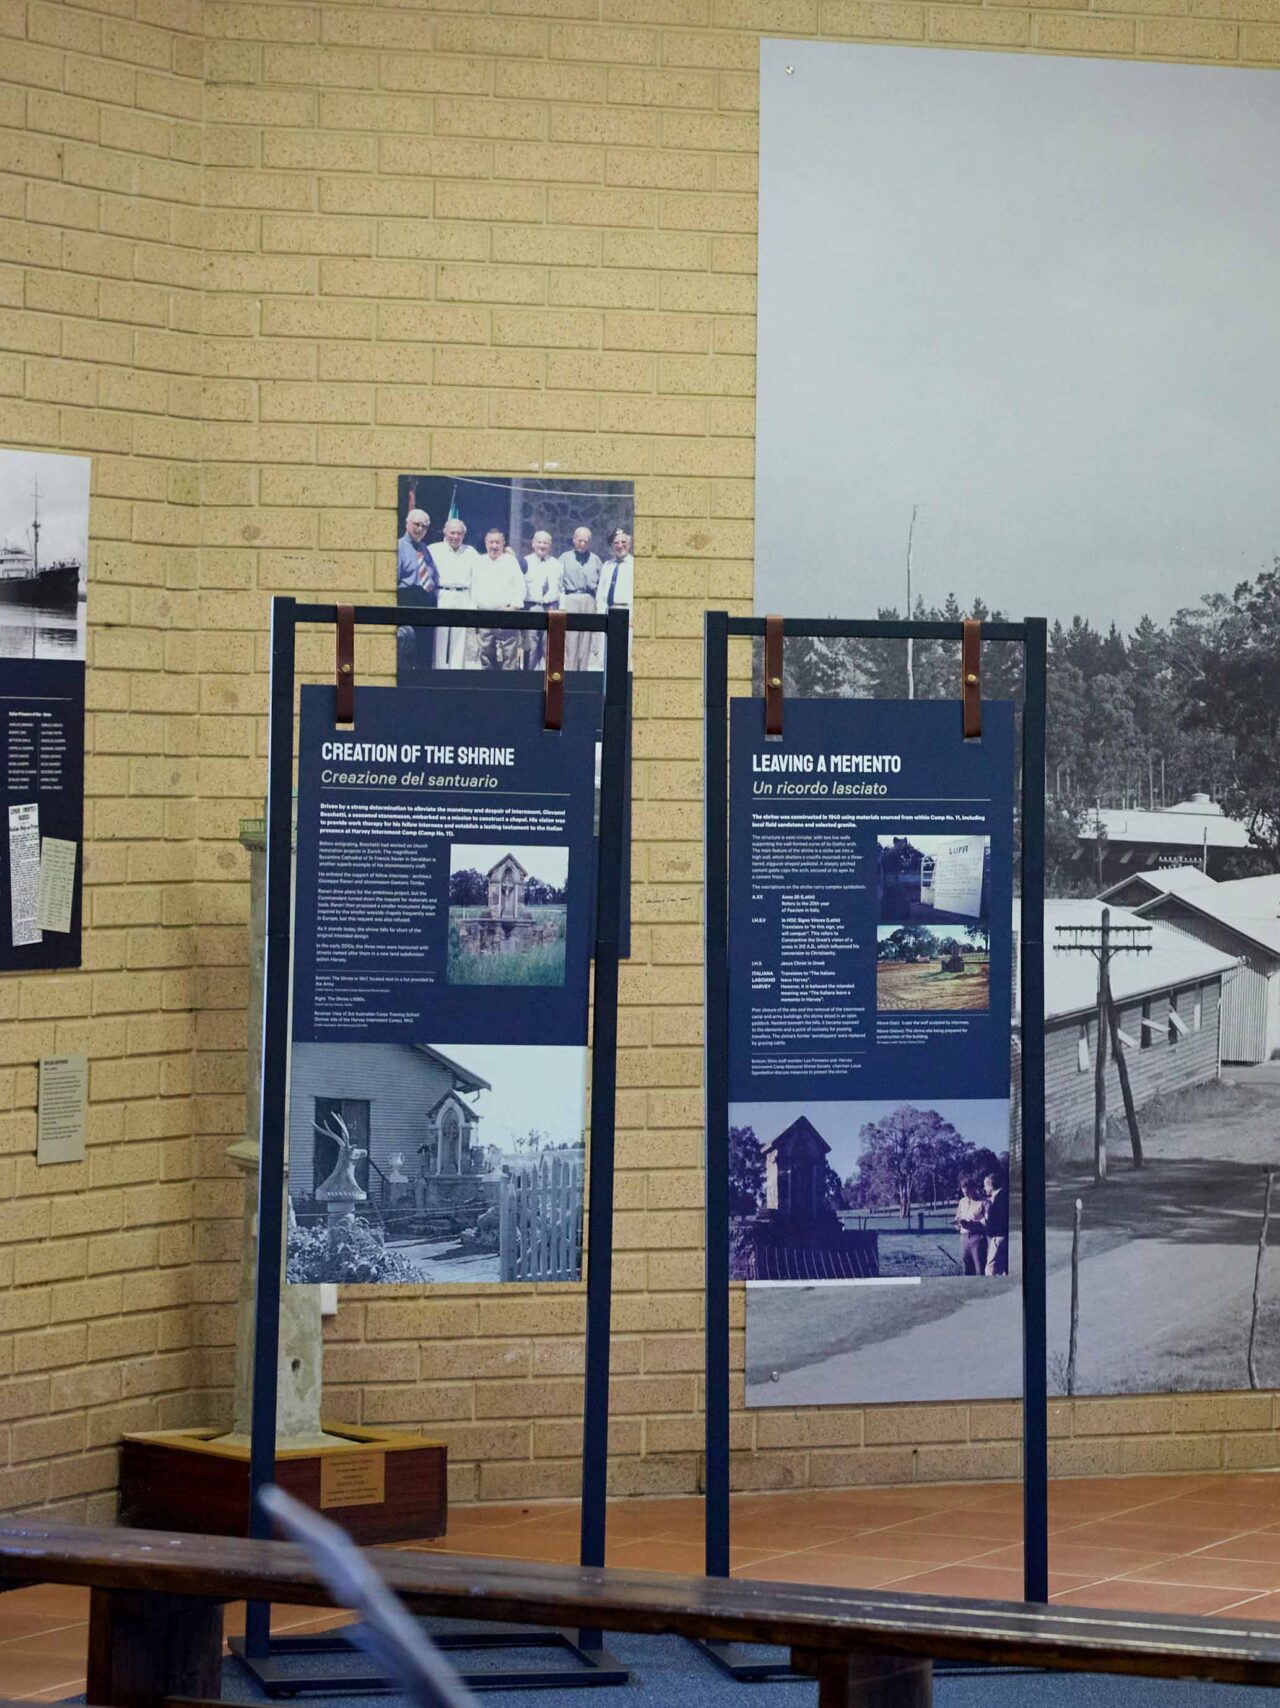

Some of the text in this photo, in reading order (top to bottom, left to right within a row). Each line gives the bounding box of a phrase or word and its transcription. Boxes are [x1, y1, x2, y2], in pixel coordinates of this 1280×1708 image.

[322, 742, 514, 766] CREATION OF THE SHRINE
[753, 755, 901, 772] LEAVING A MEMENTO
[322, 770, 498, 788] Creazione del santuario
[753, 781, 887, 794] Un ricordo lasciato
